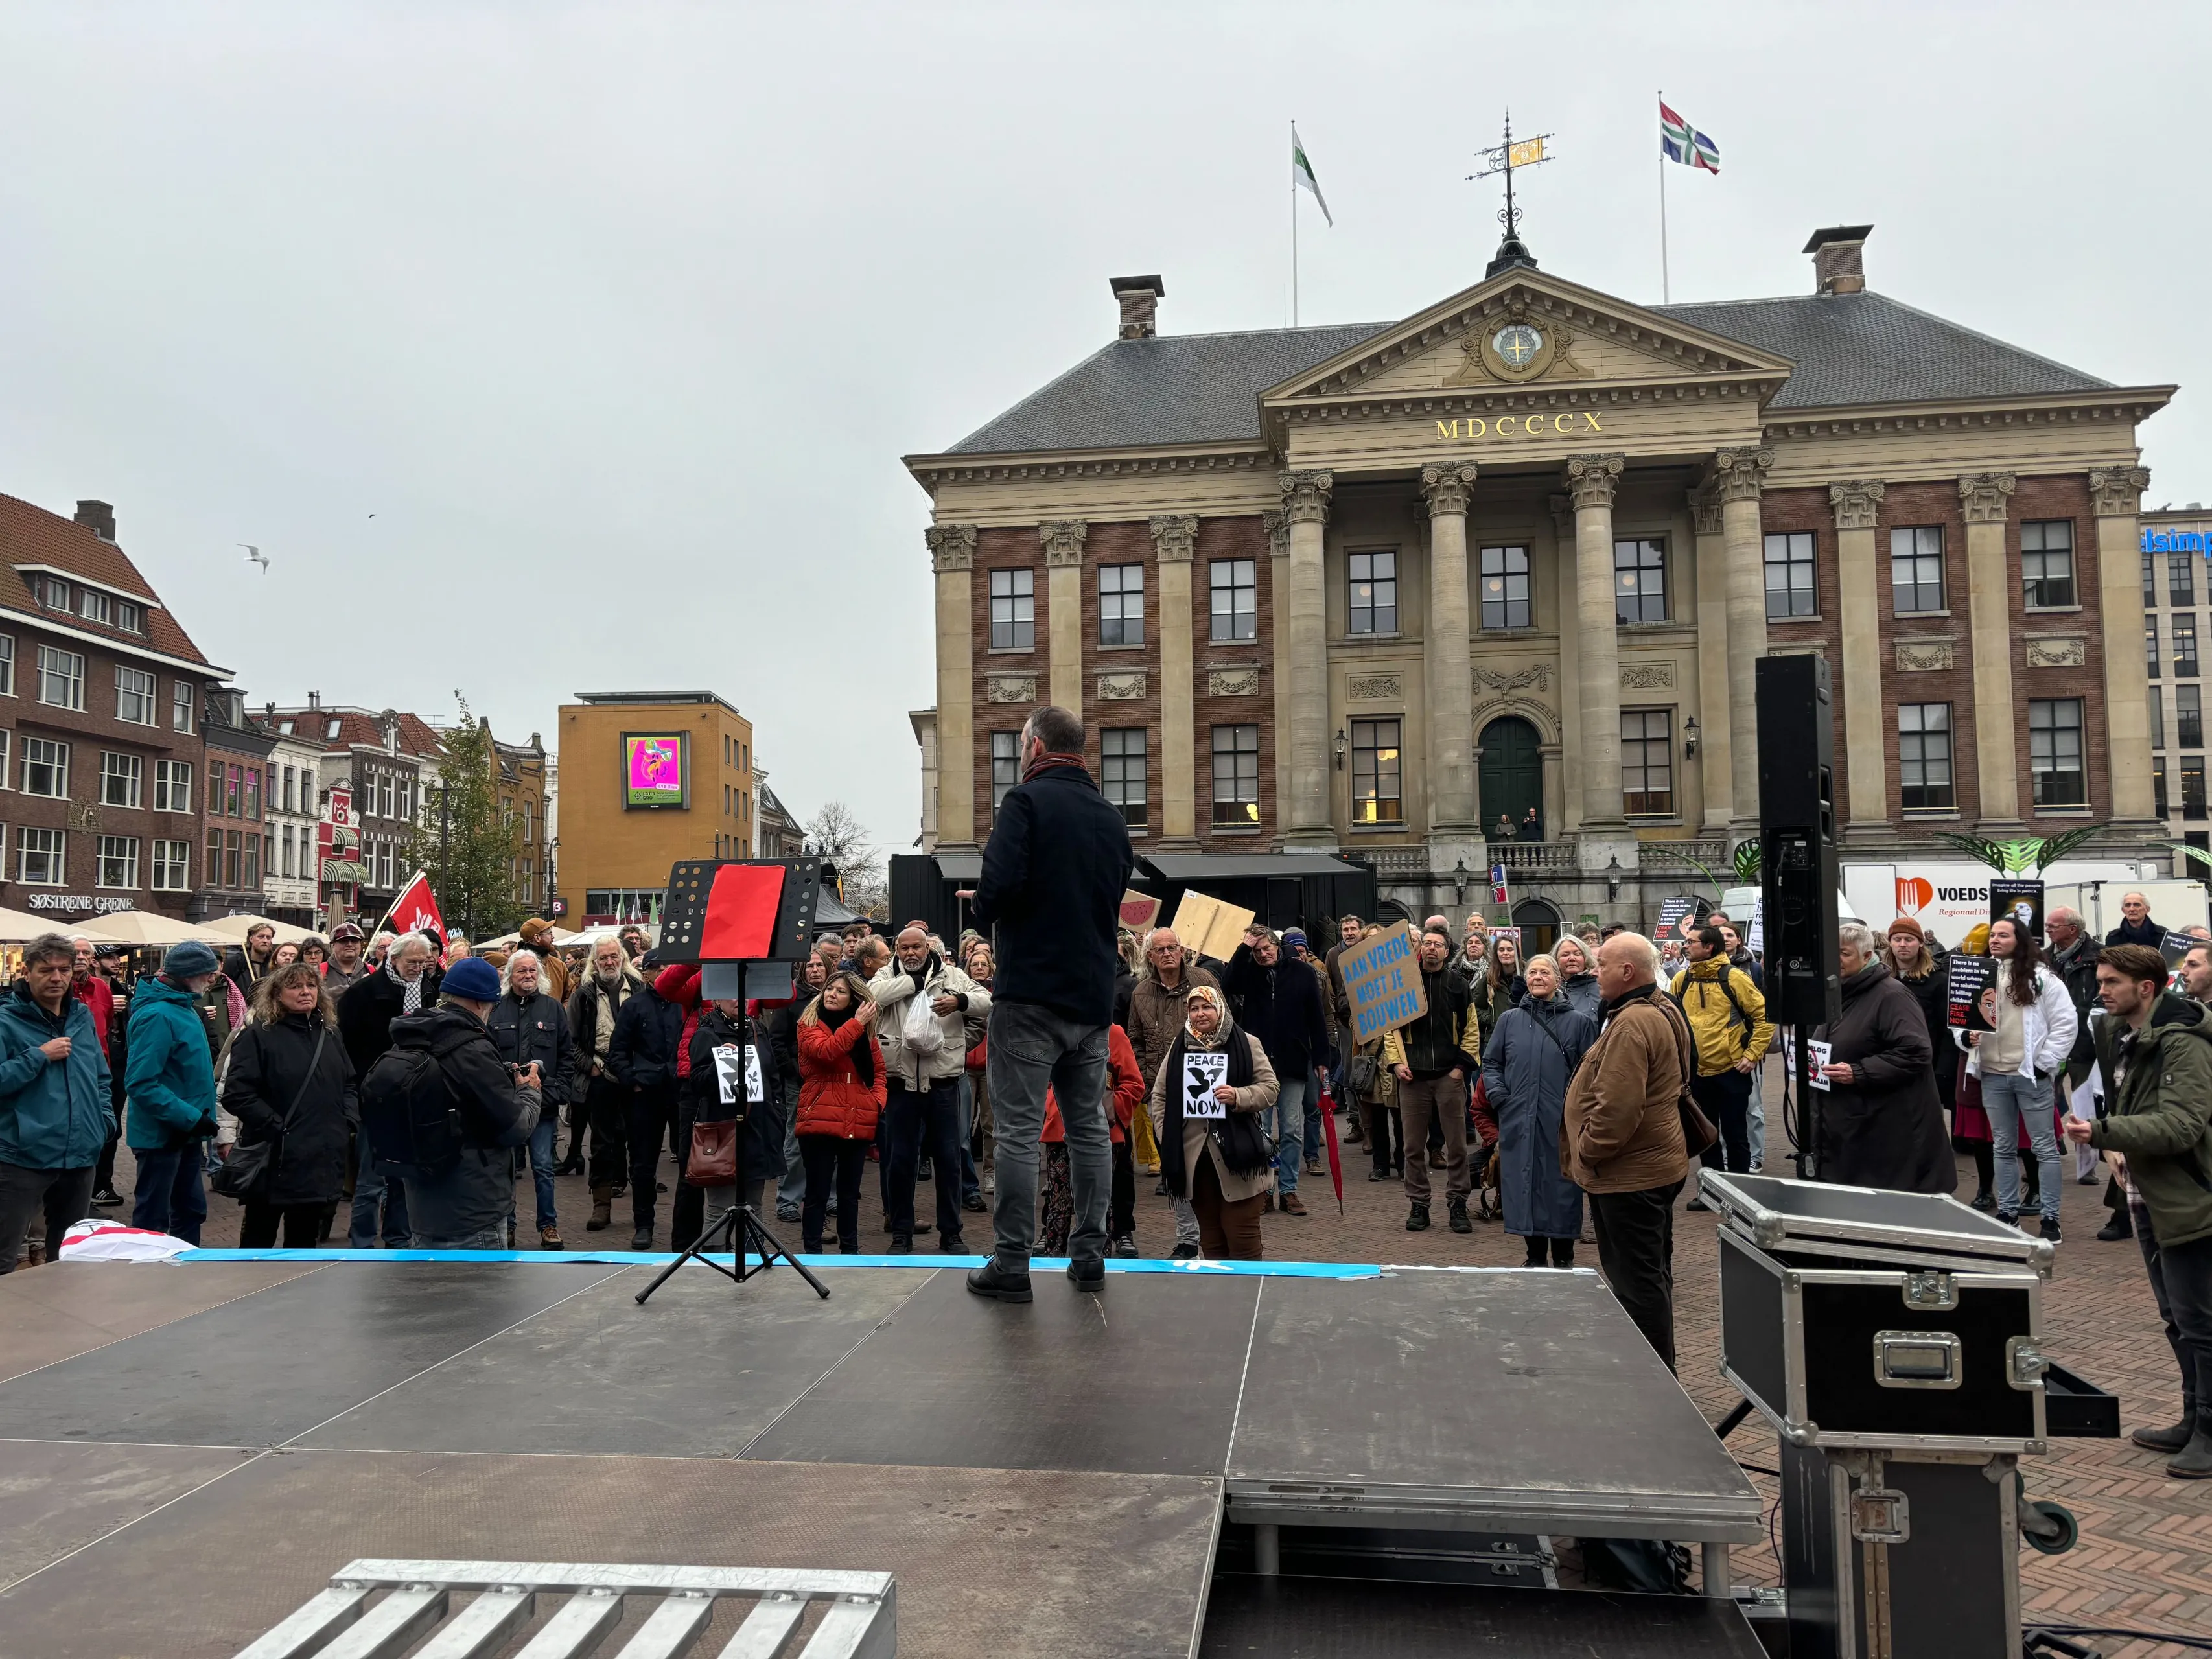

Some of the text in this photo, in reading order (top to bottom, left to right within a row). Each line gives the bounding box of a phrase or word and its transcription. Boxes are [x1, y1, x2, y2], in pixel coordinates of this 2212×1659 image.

[1436, 412, 1603, 439] MDCCCX
[1938, 888, 1990, 901] VOEDS
[28, 894, 134, 913] SØSTRENE GRENE
[1938, 908, 1977, 917] Regionaal
[1344, 933, 1410, 984] AAN VREDE
[1356, 968, 1405, 1004] MOET JE
[1357, 989, 1419, 1036] BOUWEN
[716, 1047, 754, 1056] PEAE
[1187, 1055, 1224, 1067] PEACE
[723, 1084, 759, 1100] NW
[1187, 1100, 1222, 1115] NOW
